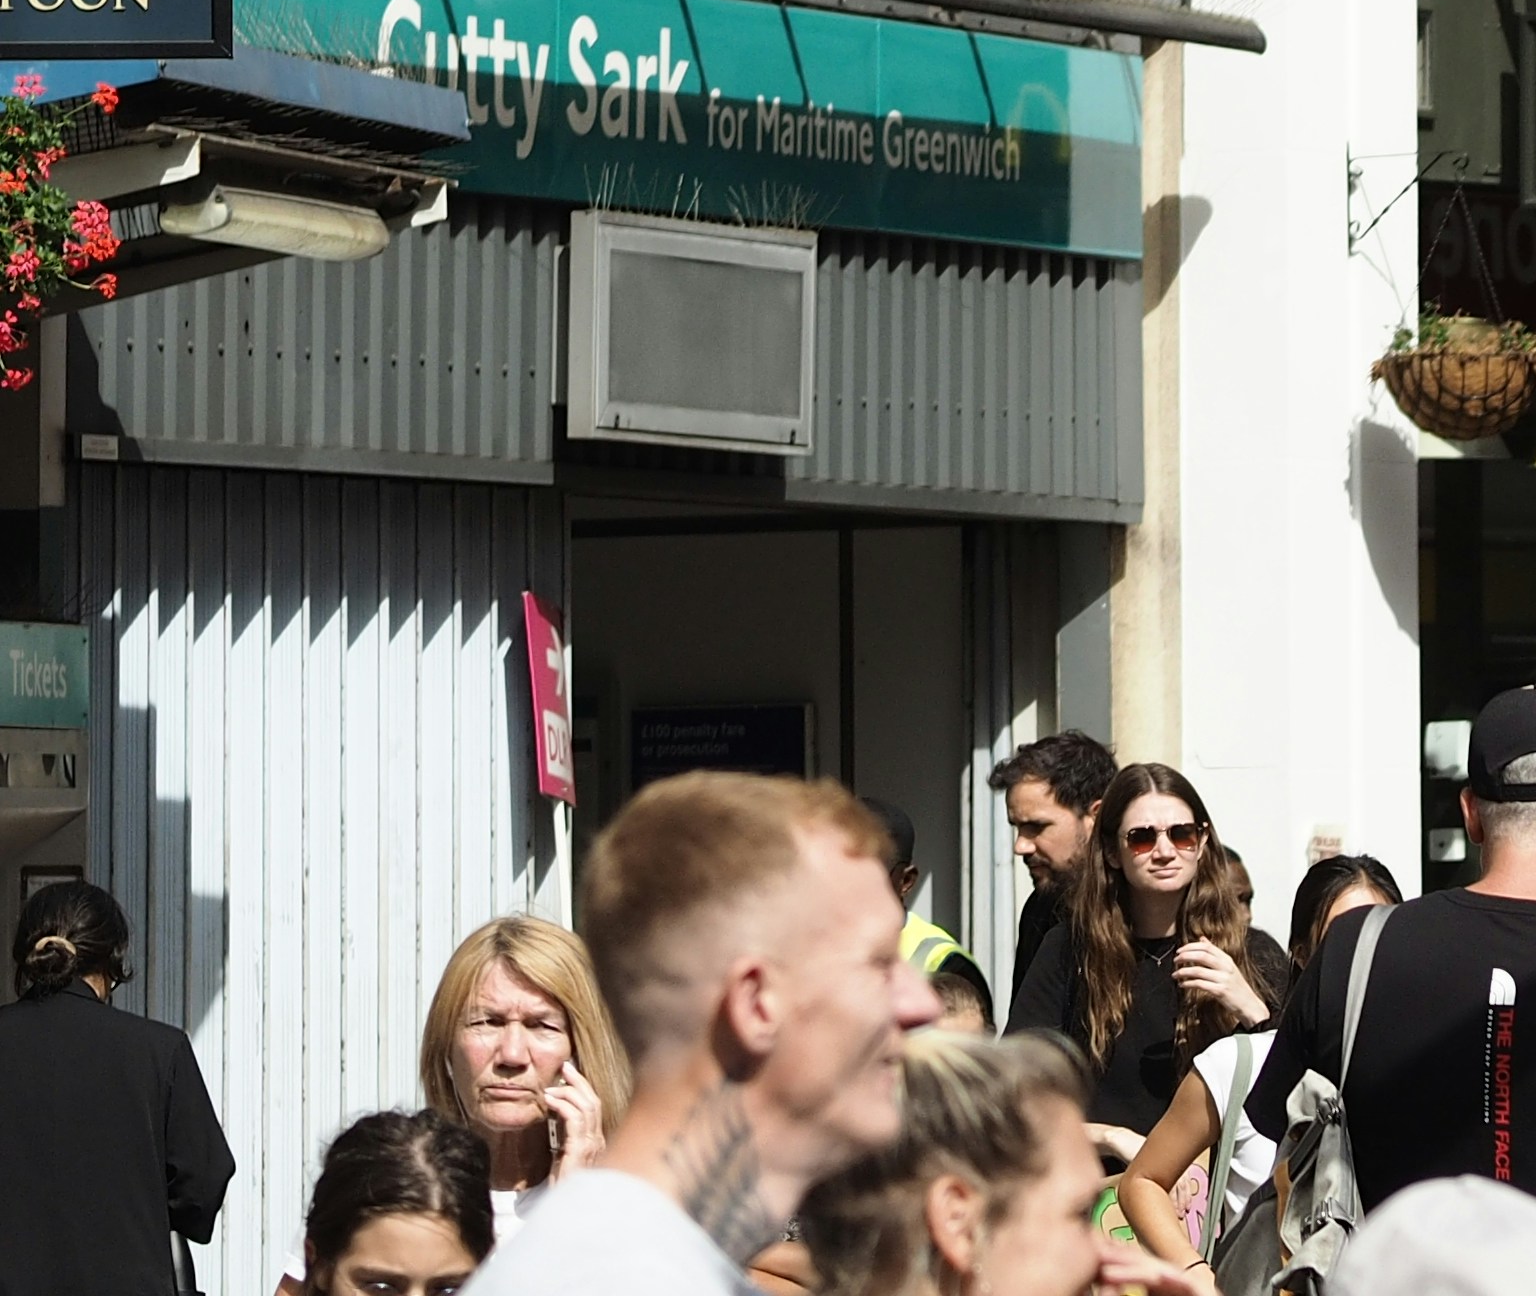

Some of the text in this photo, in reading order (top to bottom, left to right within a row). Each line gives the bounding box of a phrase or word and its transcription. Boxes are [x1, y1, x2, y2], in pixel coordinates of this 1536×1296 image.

[566, 15, 690, 145] Sark
[706, 88, 748, 150] for
[755, 95, 874, 166] Maritime
[882, 109, 1021, 182] Greenwich
[10, 649, 67, 699] Tickets
[656, 742, 729, 758] prosecution
[673, 722, 718, 741] penalty
[720, 722, 746, 737] fare
[1494, 1008, 1515, 1180] THE NORTH FACE
